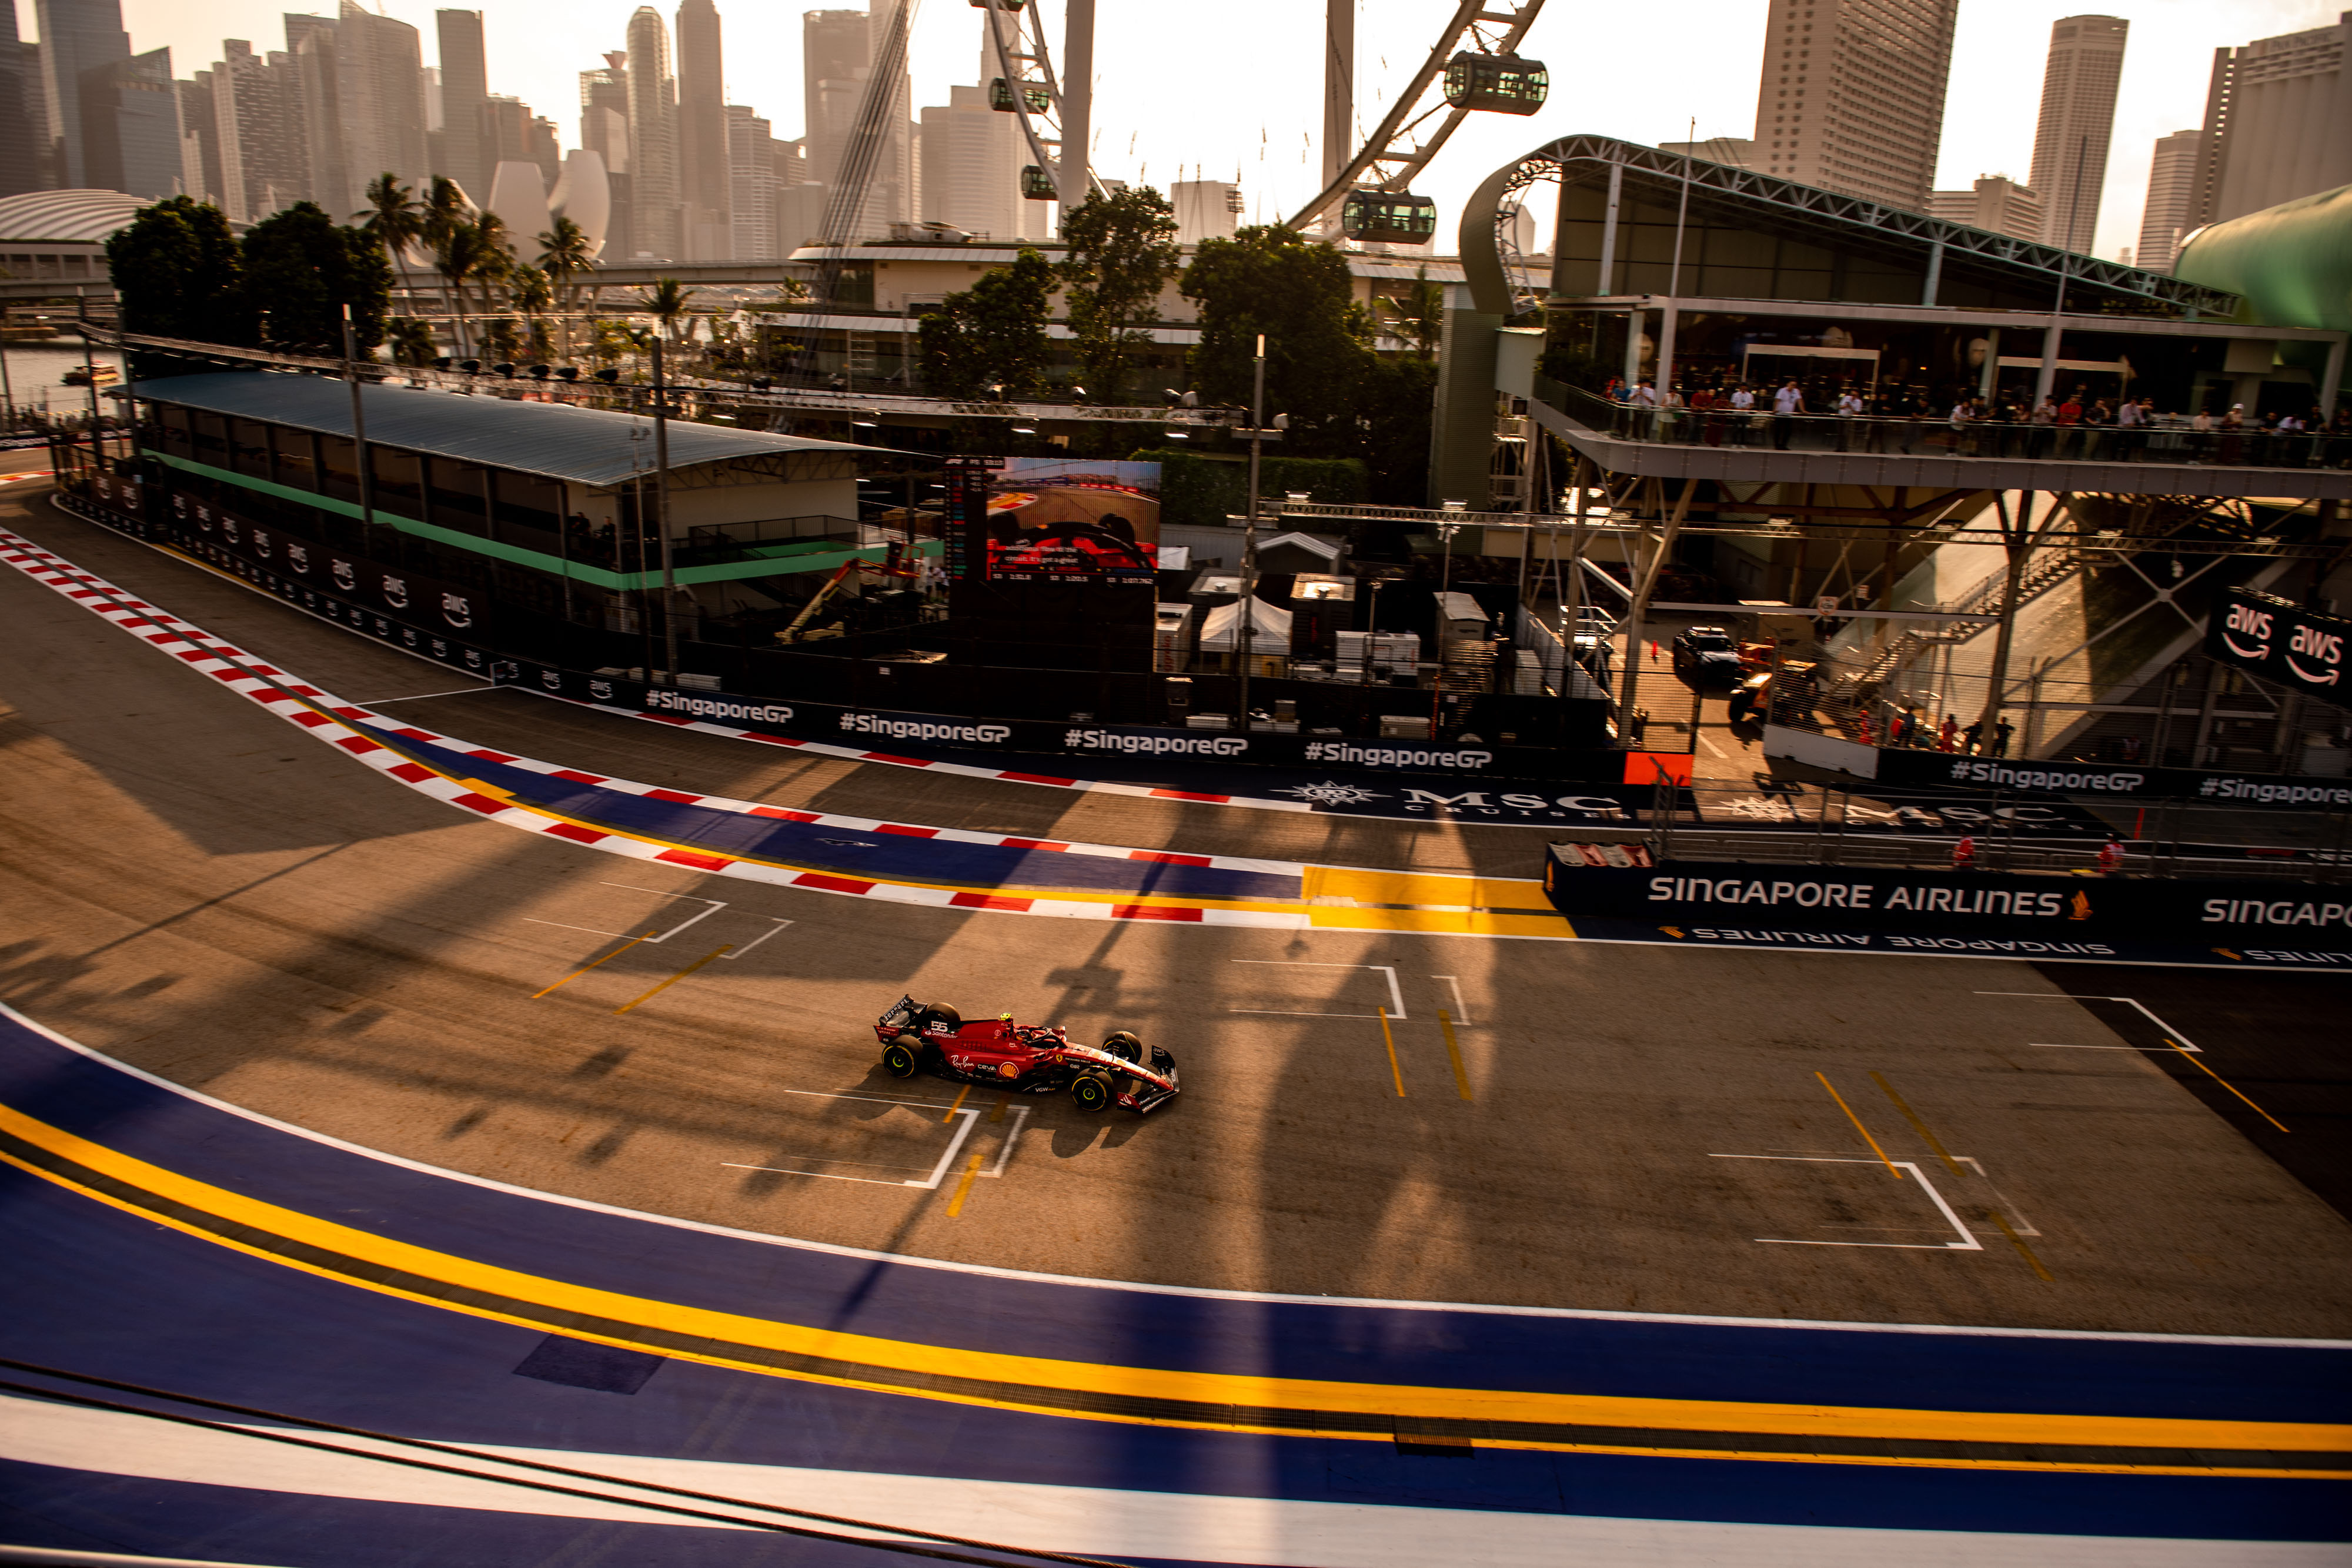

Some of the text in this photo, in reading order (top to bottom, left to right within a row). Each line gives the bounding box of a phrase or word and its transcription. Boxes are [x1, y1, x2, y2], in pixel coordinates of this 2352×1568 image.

[2226, 604, 2274, 640] aws
[2290, 625, 2343, 664] aws
[646, 689, 793, 724] #SingaporeGP
[840, 713, 1011, 743] #SingaporeGP
[1064, 728, 1249, 756] #SingaporeGP
[1305, 741, 1494, 769] #SingaporeGP
[1950, 761, 2145, 791] #SingaporeGP
[1400, 788, 1621, 811] MSC
[2199, 777, 2352, 804] #Singapore
[1404, 805, 1632, 820] CRUISES
[1648, 877, 2063, 917] SINGAPORE AIRLINES
[883, 998, 910, 1022] Ferrari
[931, 1021, 948, 1032] 55
[931, 1030, 958, 1039] Santander
